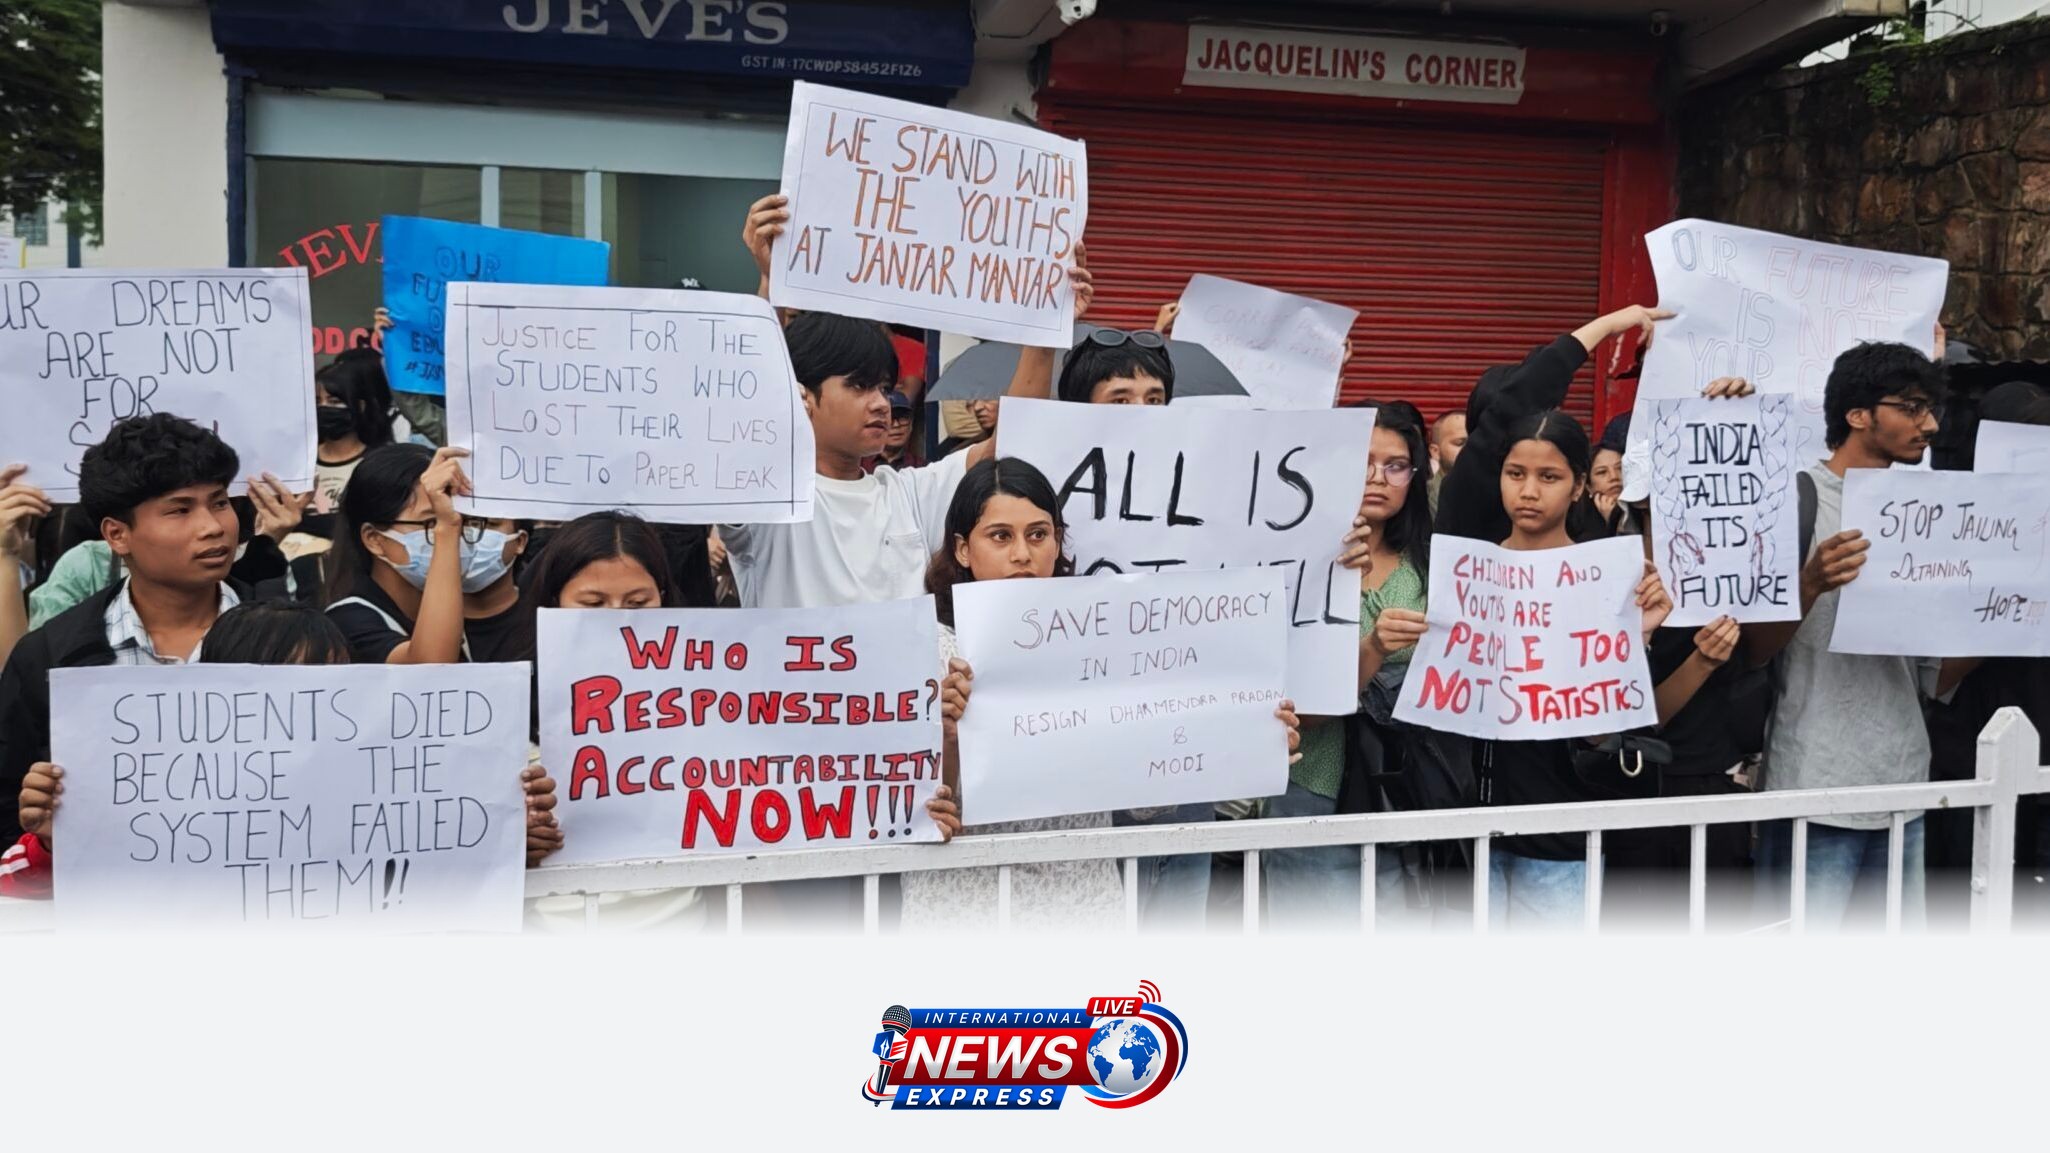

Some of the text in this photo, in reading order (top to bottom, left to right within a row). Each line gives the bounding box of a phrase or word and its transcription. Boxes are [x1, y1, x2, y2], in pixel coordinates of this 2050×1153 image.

[502, 0, 790, 45] JEVE'S
[741, 55, 770, 69] GST
[1197, 38, 1517, 89] JACQUELIN'S CORNER
[825, 111, 1076, 202] WE STAND WITH
[854, 166, 1071, 260] THE YOUTHS
[788, 224, 1064, 310] AT JANTAR MANTAR
[1765, 245, 1912, 316] FUTURE
[112, 279, 273, 327] DREAMS
[1735, 287, 1775, 348] IS
[38, 327, 241, 379] ARE NOT
[481, 304, 763, 357] JUSTICE FOR THE
[79, 374, 159, 420] FOR
[495, 348, 759, 401] STUDENTS WHO
[491, 389, 779, 446] LOST THEIR LIVES
[499, 444, 779, 492] DUE TO PAPER LEAK
[1685, 422, 1765, 467] INDIA
[1057, 446, 1315, 532] ALL IS
[1680, 472, 1764, 510] FAILED
[1701, 516, 1748, 549] ITS
[1880, 499, 2020, 551] STOP JAILING
[1453, 553, 1602, 590] CHILDREN AND
[1680, 573, 1789, 608] FUTURE
[1013, 591, 1273, 650] SAVE DEMOCRACY
[1455, 580, 1553, 628] YOUTHS ARE
[619, 625, 858, 672] WHO IS
[1078, 646, 1199, 681] IN INDIA
[1443, 620, 1631, 673] PEOPLE TOO
[570, 674, 939, 737] RESPONSIBLE?
[1013, 687, 1287, 737] RESIGN DHARMENDRA PRADAN
[1415, 665, 1493, 715] NOT
[110, 688, 493, 745] STUDENTS DIED
[112, 744, 446, 806] BECAUSE THE
[568, 744, 942, 801] ACCOUNTABILITY
[1148, 753, 1205, 778] MODI
[129, 796, 489, 864] SYSTEM FAILED
[681, 784, 915, 850] NOW!!!
[223, 857, 411, 922] THEM!!
